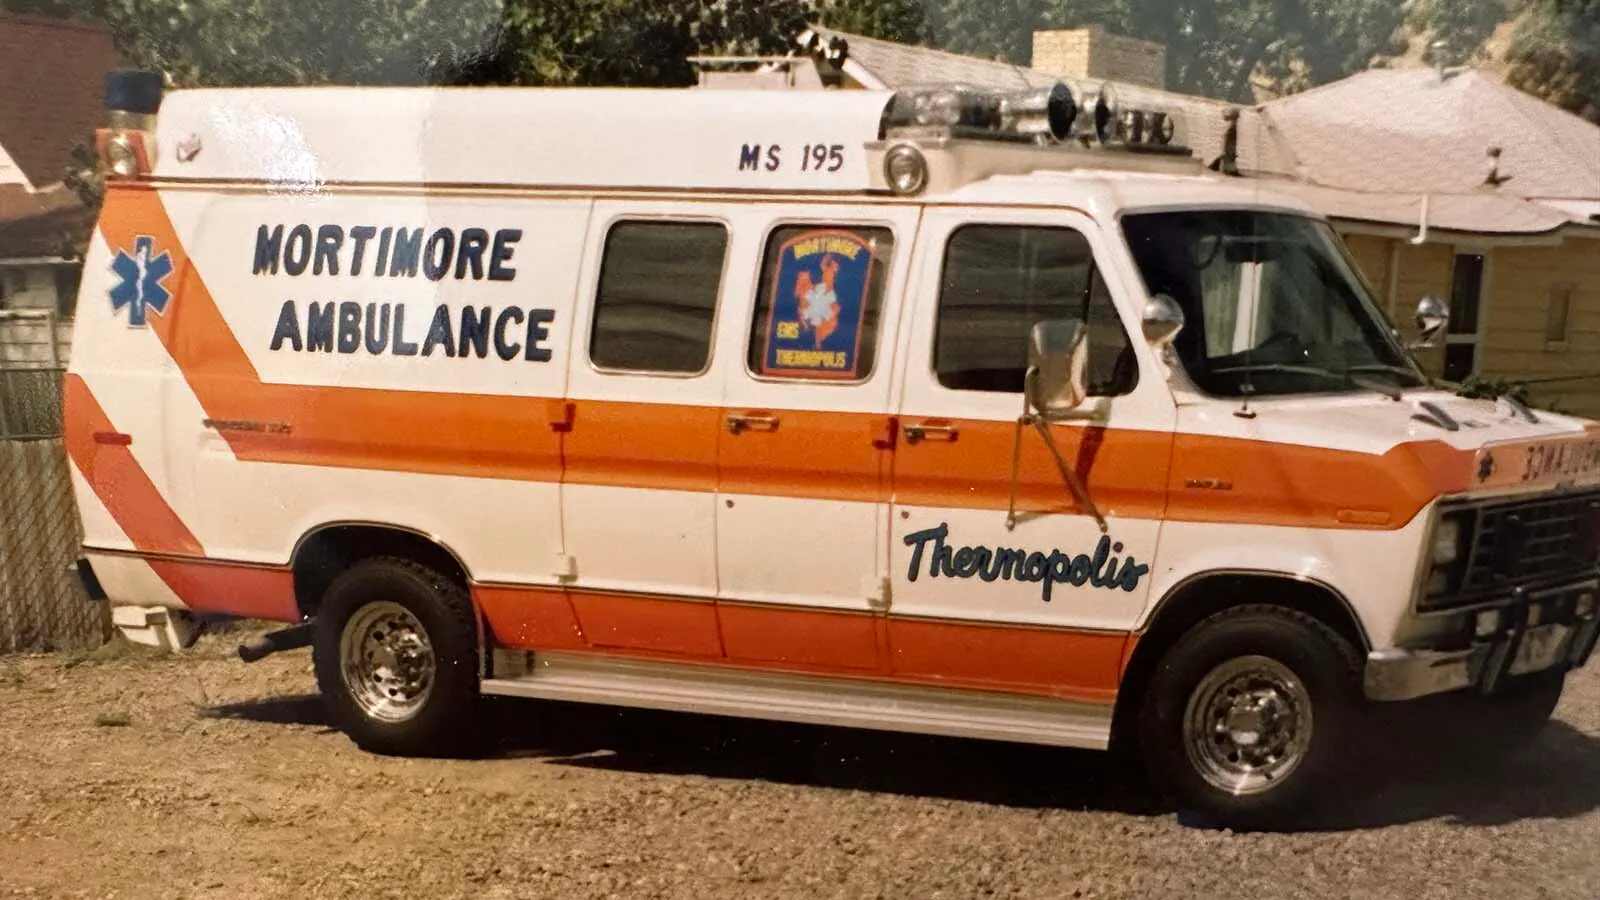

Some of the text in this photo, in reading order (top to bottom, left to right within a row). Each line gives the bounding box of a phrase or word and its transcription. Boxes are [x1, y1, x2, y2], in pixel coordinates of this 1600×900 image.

[801, 144, 844, 172] 195
[252, 223, 523, 281] MORTIMORE
[269, 300, 556, 362] AMBULANCE
[904, 522, 1149, 602] Thermopolis
